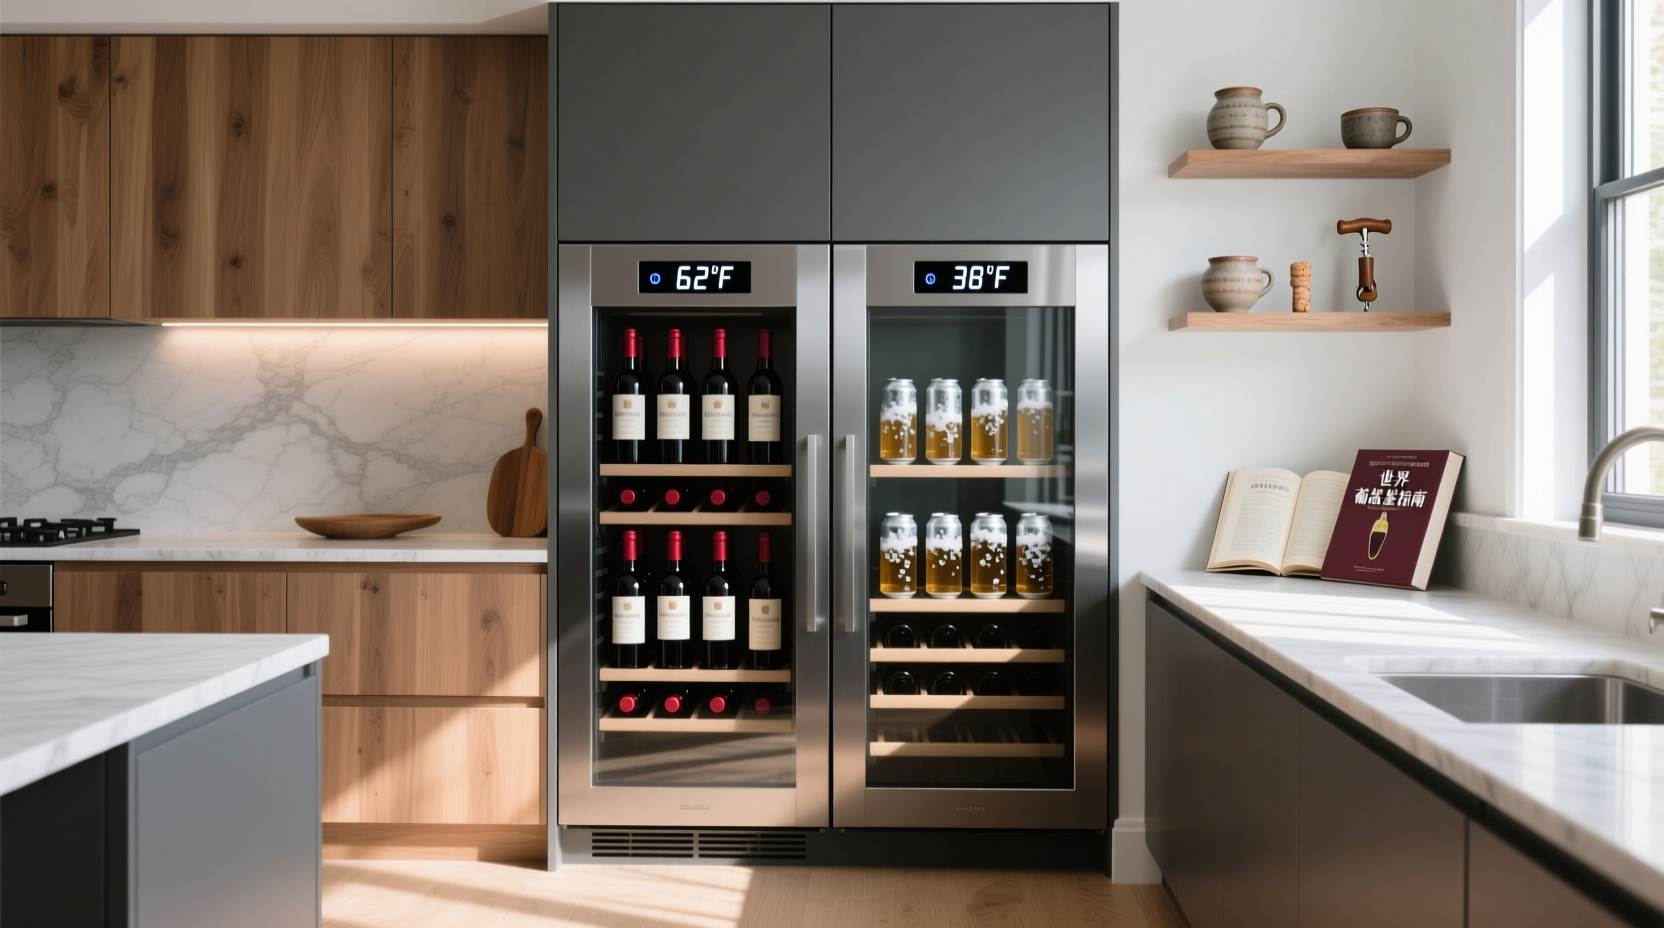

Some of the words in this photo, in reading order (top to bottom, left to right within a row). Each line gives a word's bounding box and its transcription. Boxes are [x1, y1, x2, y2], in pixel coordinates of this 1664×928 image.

[676, 265, 734, 290] 62°F
[952, 265, 1010, 290] 38°F
[1379, 469, 1410, 488] 世界
